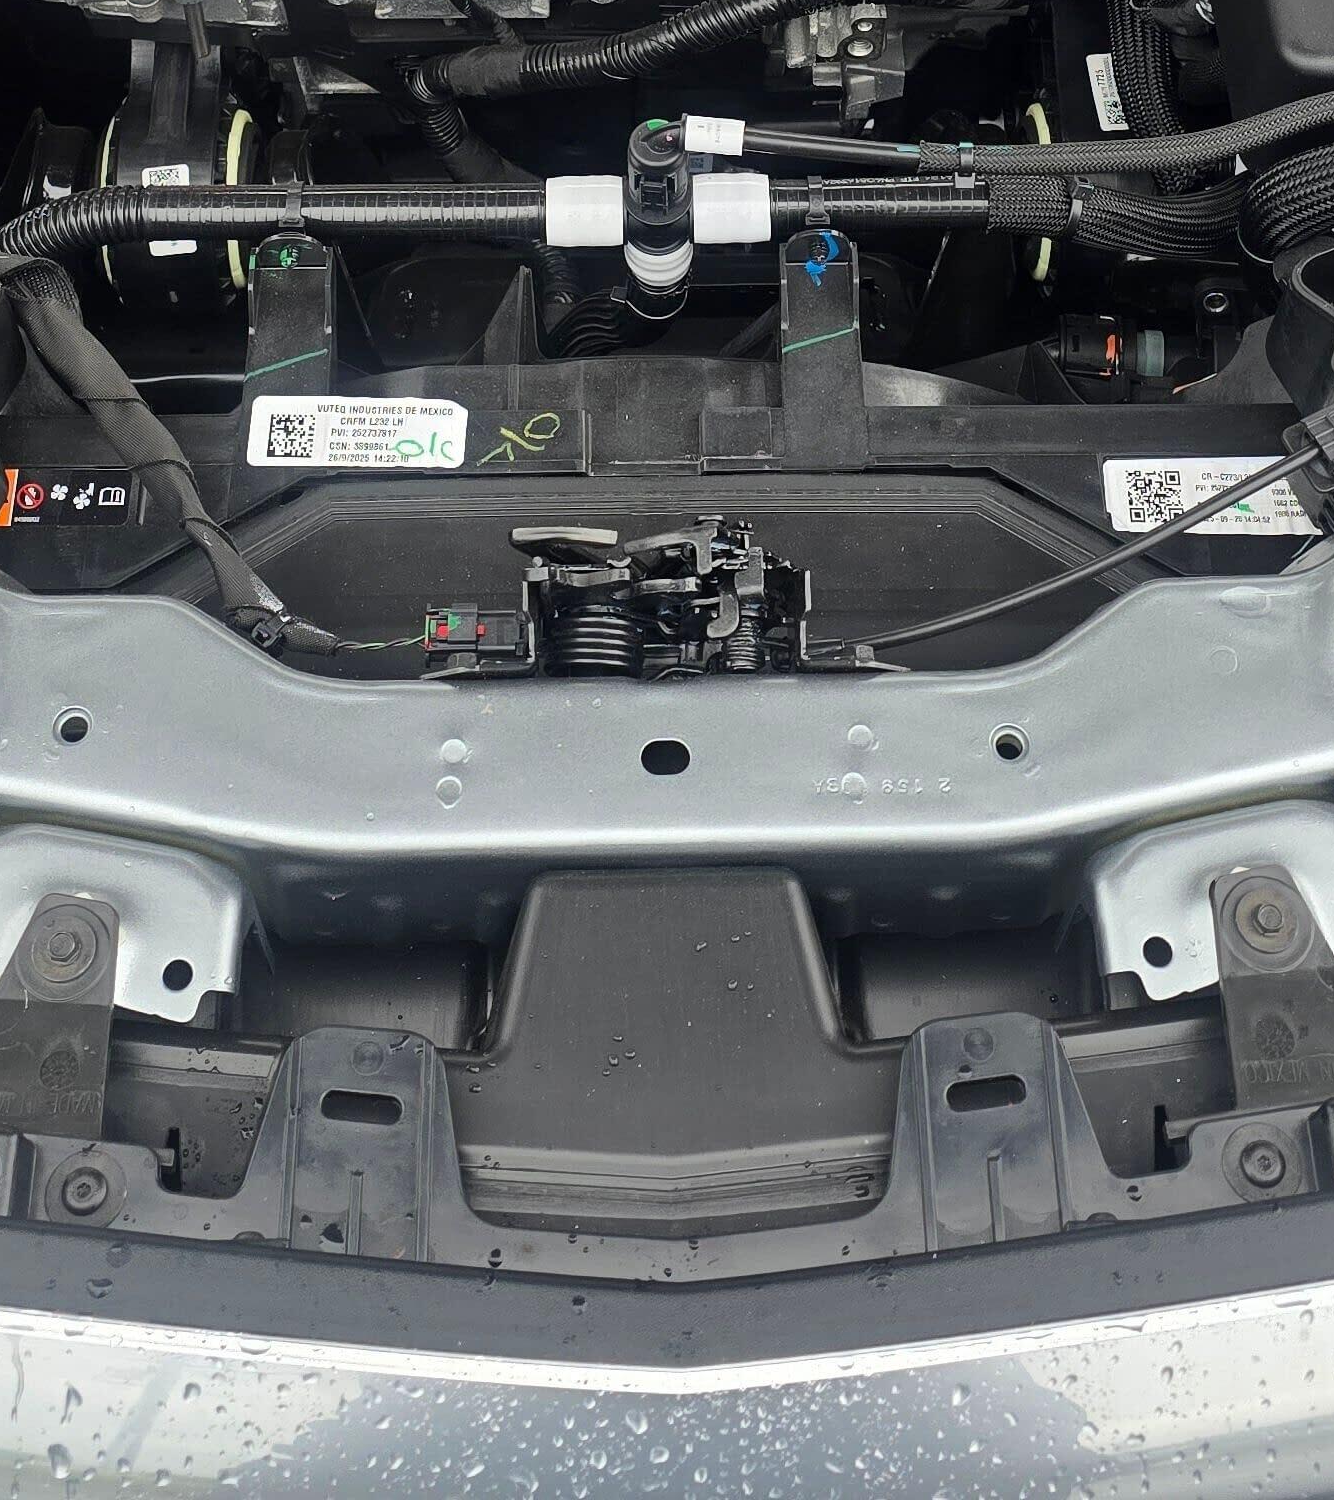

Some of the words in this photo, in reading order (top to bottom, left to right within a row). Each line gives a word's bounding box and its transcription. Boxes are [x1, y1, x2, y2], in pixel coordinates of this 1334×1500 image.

[317, 404, 346, 414] VUTEQ
[349, 406, 402, 415] INDUSTRIES
[405, 406, 416, 415] DE
[420, 407, 454, 416] MEXICO
[369, 417, 389, 426] L232
[329, 442, 351, 451] CSN:
[328, 454, 370, 463] 26/9/2025
